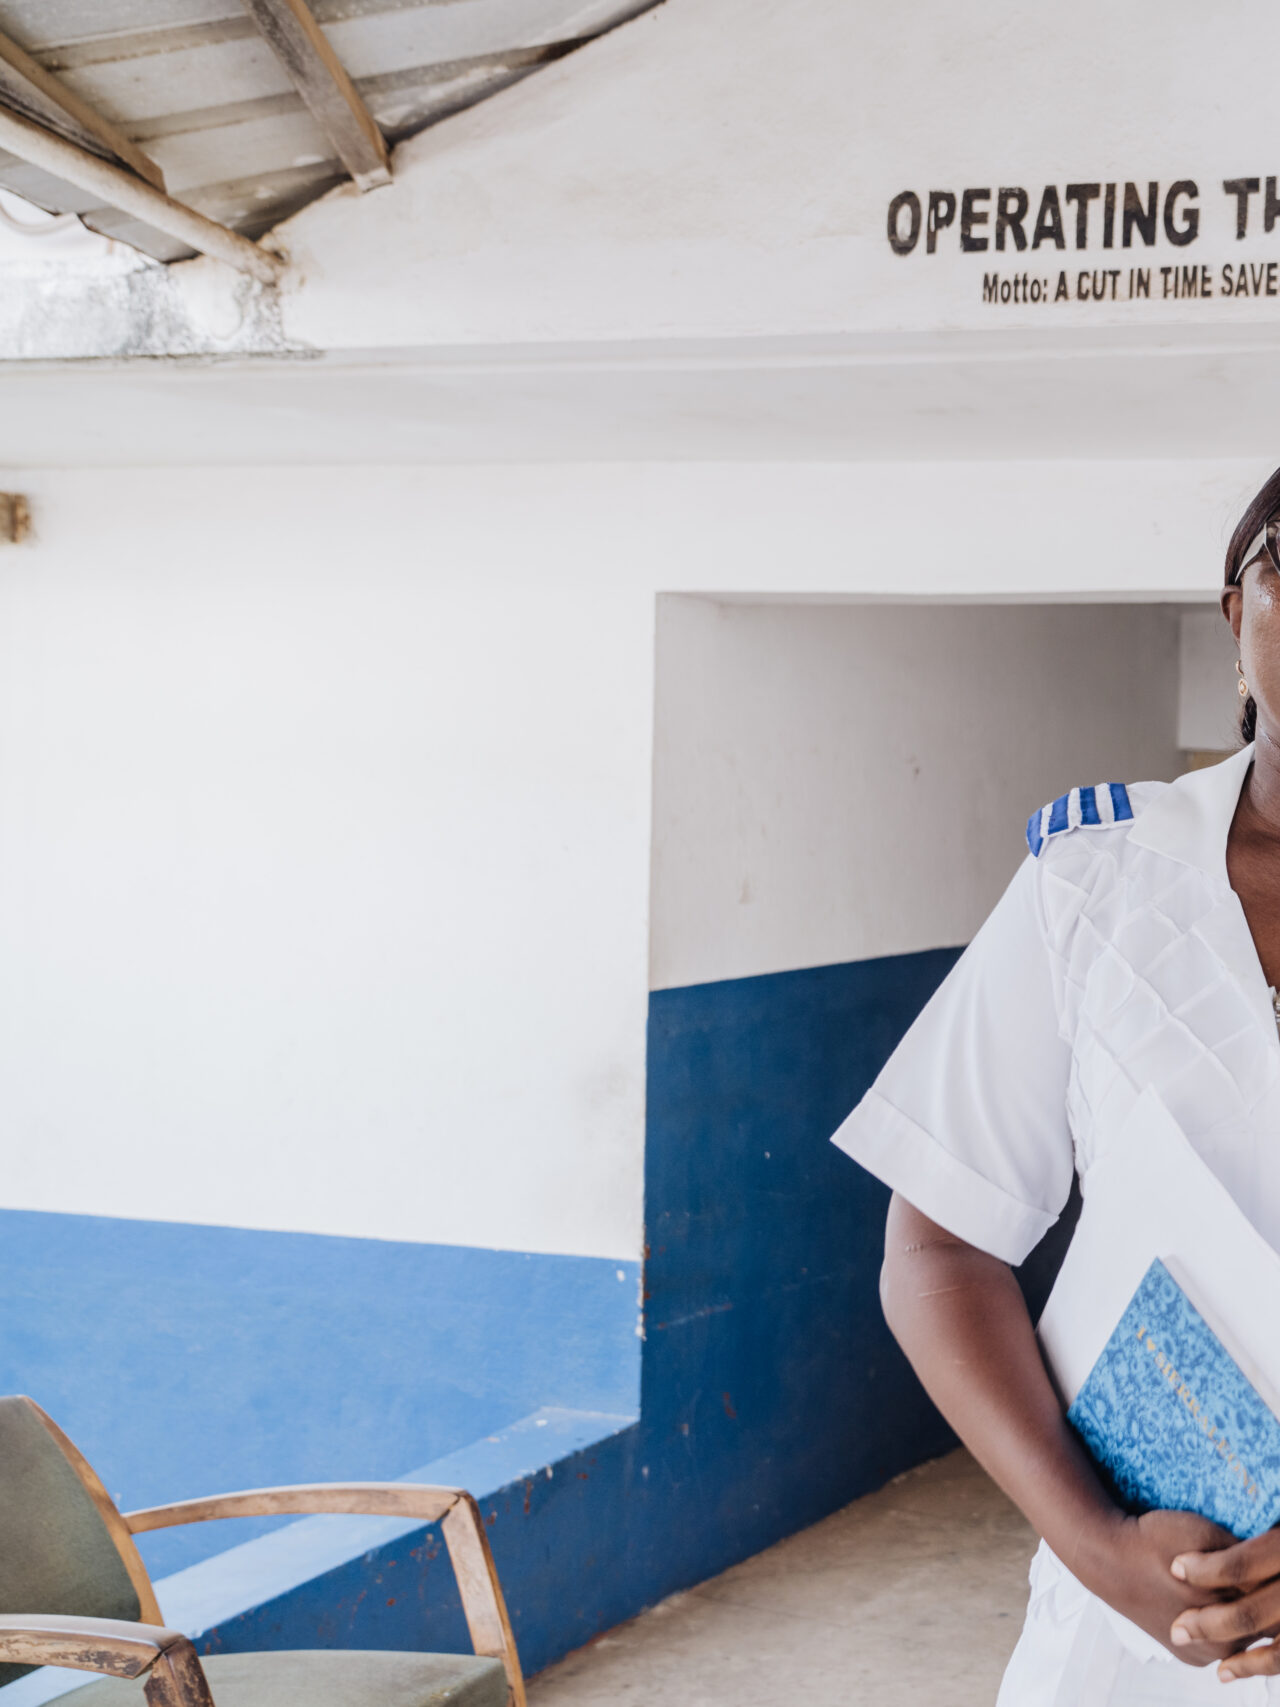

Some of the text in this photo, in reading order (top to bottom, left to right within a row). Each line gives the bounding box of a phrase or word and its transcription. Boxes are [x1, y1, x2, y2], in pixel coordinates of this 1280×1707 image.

[886, 179, 1200, 257] OPERATING
[982, 272, 1048, 305] Motto:
[1054, 270, 1070, 303] A
[1076, 269, 1122, 302] CUT
[1128, 267, 1151, 300] IN
[1159, 264, 1213, 300] TIME
